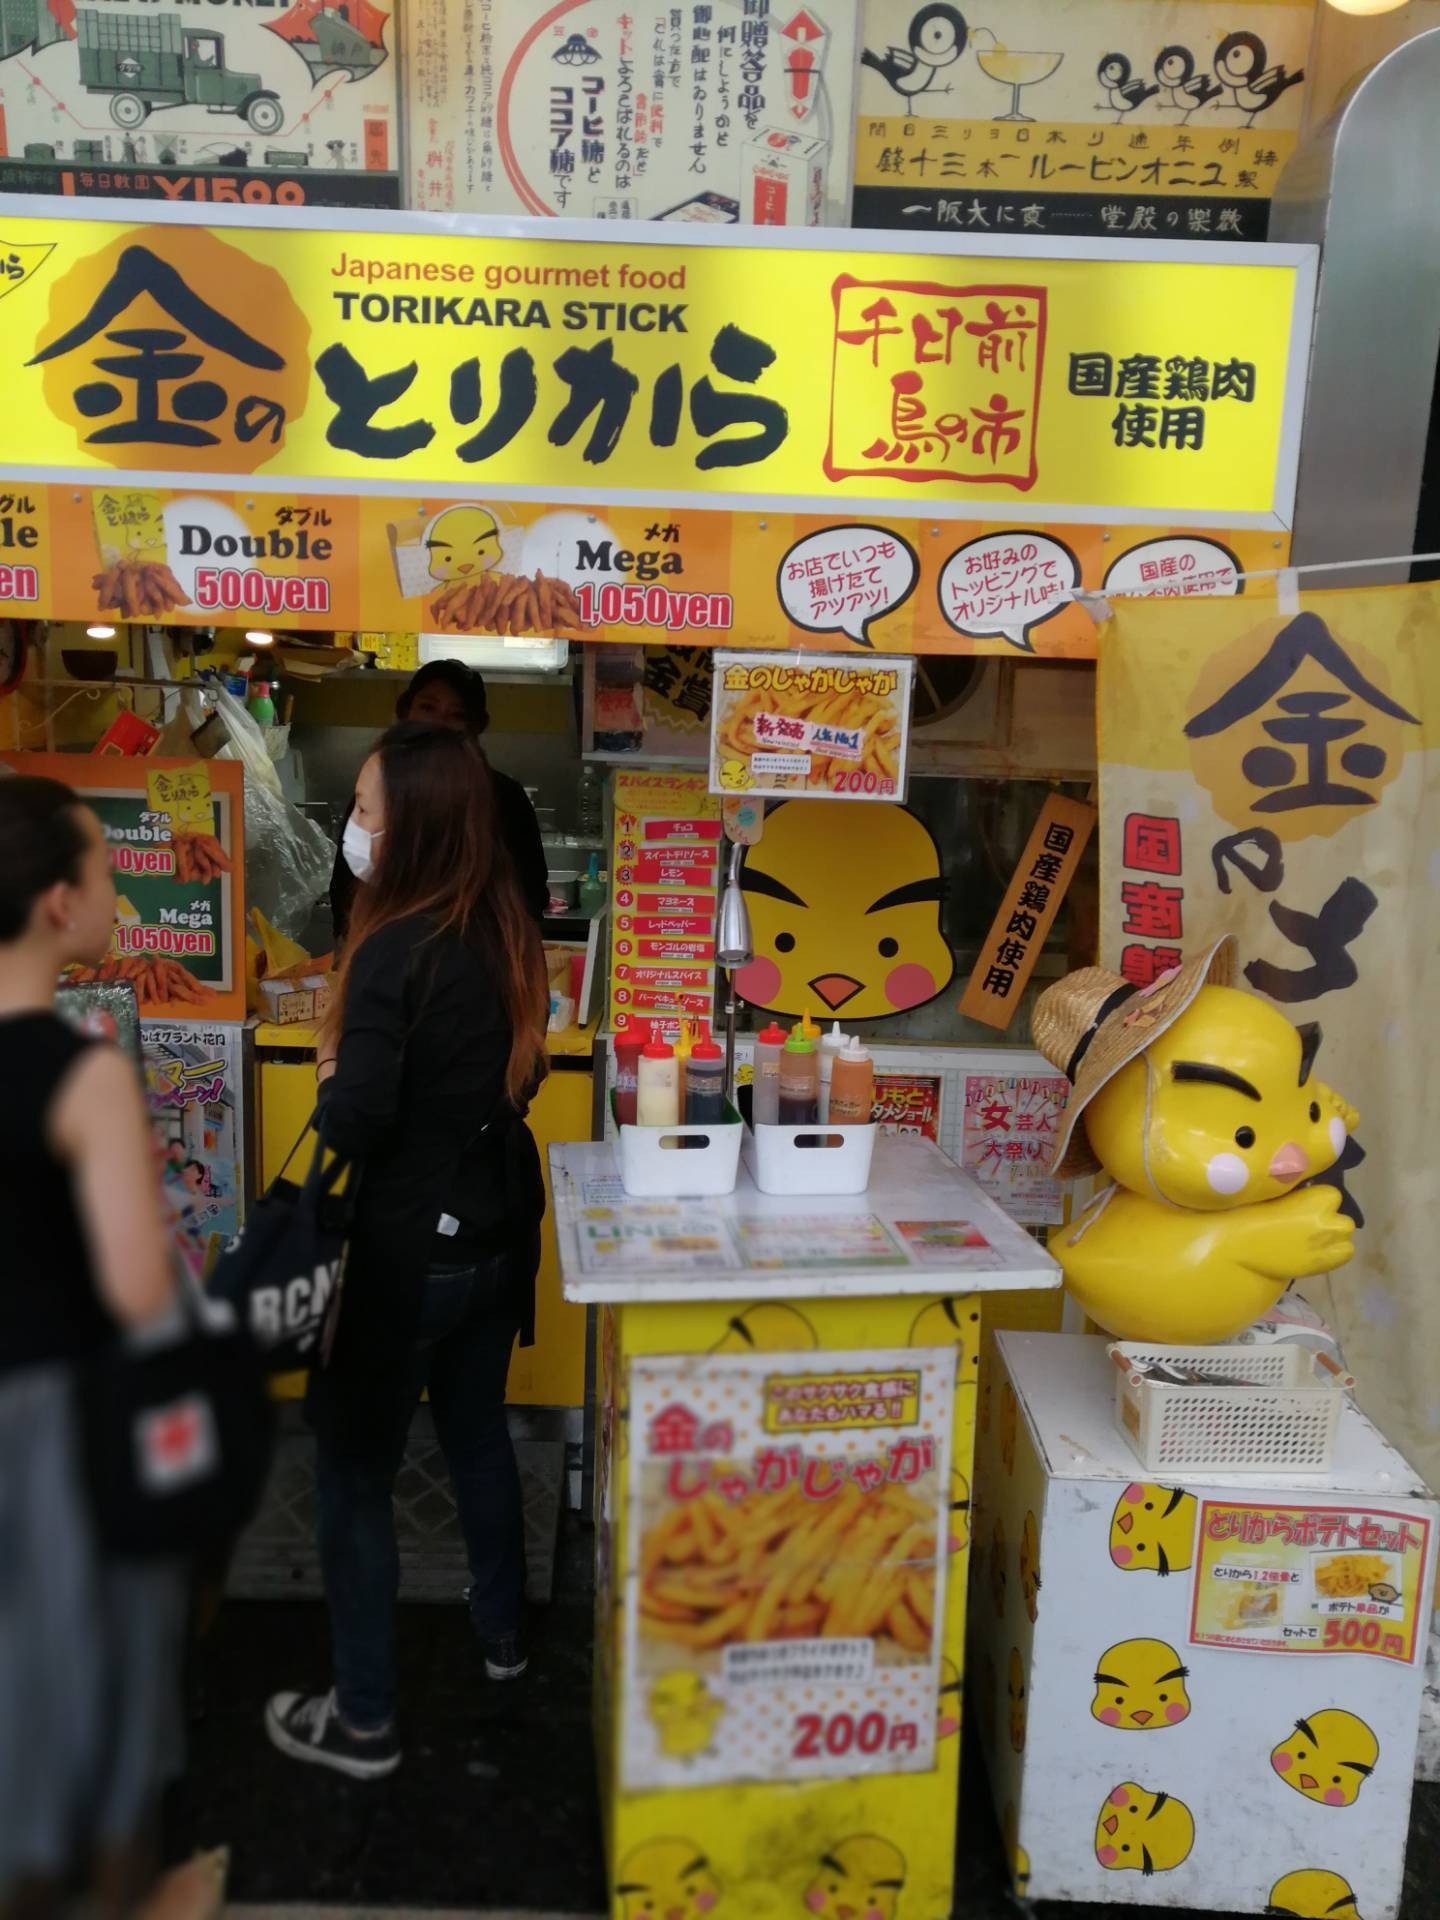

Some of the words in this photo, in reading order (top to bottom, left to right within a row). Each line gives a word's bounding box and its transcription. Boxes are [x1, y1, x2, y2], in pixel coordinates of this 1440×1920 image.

[331, 252, 475, 284] Japanese
[485, 259, 610, 290] gourmet
[618, 263, 686, 290] food
[333, 291, 551, 329] TORIKARA
[562, 301, 689, 333] STICK
[837, 297, 1037, 374] 千日前
[1068, 351, 1257, 402] 国産鶏肉
[862, 371, 1026, 465] 鳥の市
[1111, 402, 1206, 451] 使用
[275, 506, 333, 528] ダブル
[644, 523, 681, 543] メガ
[179, 525, 333, 561] Double
[575, 540, 685, 581] Mega
[786, 539, 897, 581] お店でいつも
[963, 543, 1039, 574] お好みの
[808, 567, 883, 598] 揚げたて
[950, 559, 1059, 598] トッピングで
[1139, 553, 1197, 583] 国産の
[195, 566, 331, 615] 500yen
[574, 581, 735, 630] 1,050yen
[831, 769, 896, 796] 200円
[138, 811, 172, 824] ダブル
[660, 868, 684, 878] レモン
[159, 908, 214, 929] Mega
[190, 900, 212, 912] メガ
[982, 821, 1075, 999] 国産鶏肉使用
[981, 1101, 1052, 1132] 女芸人
[1206, 1510, 1423, 1553] とりからポテトセット
[1321, 1617, 1406, 1655] 500円
[791, 1711, 919, 1760] 200円
